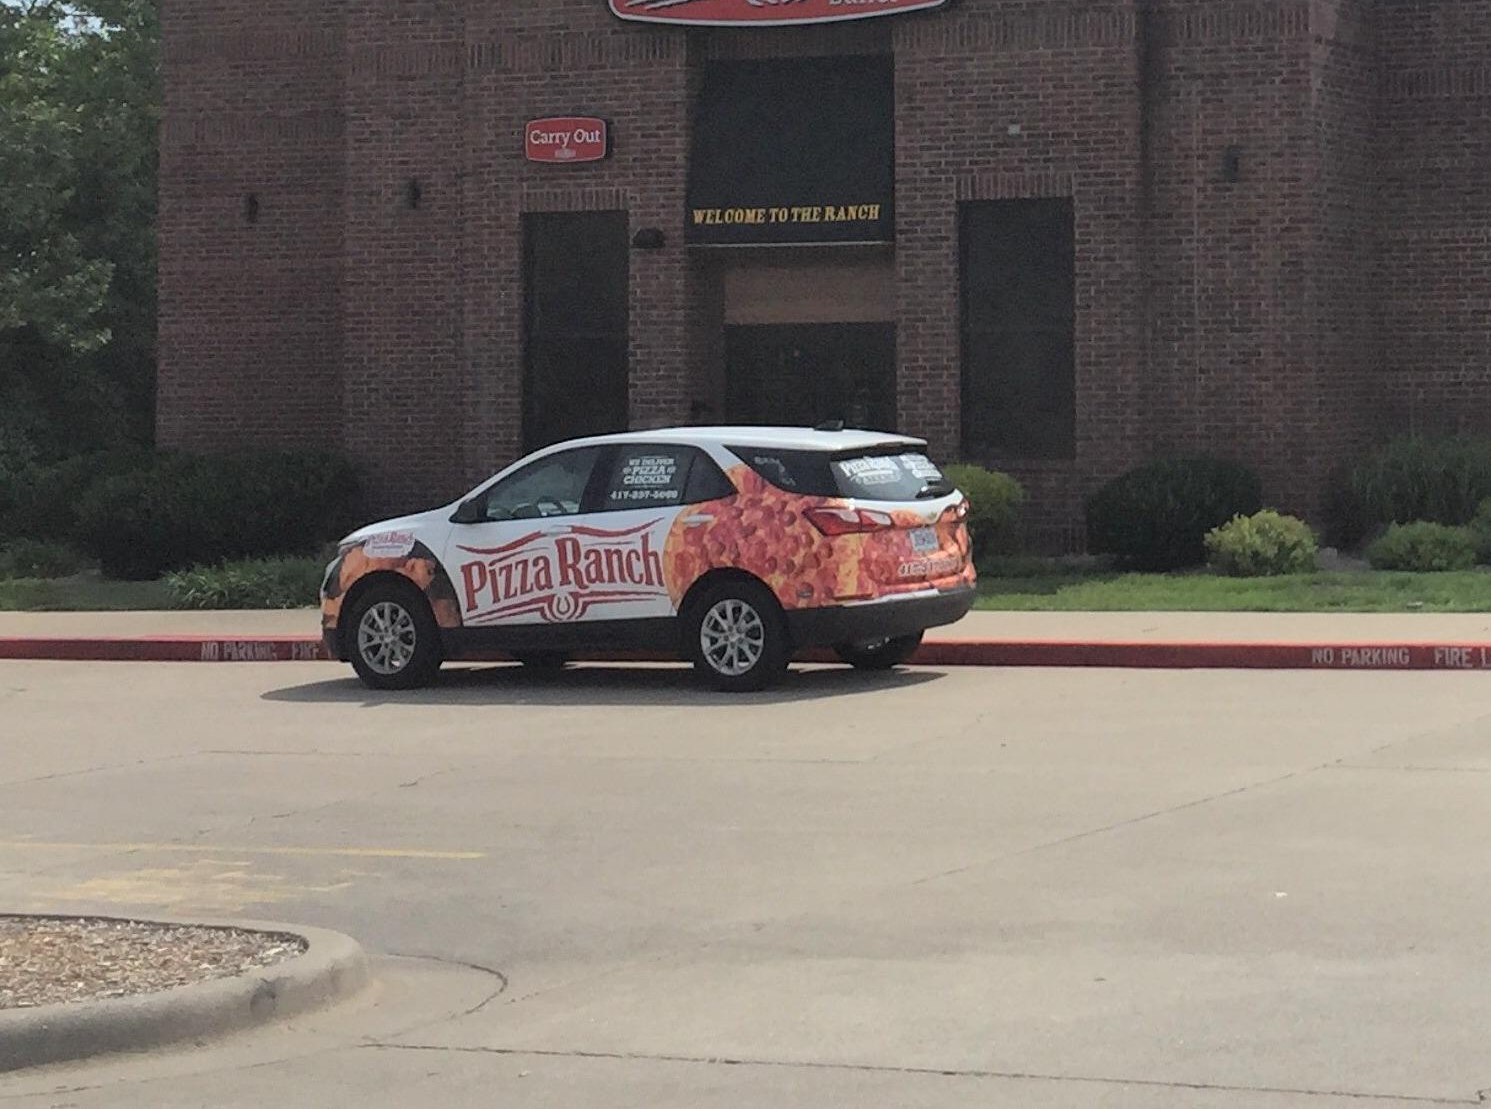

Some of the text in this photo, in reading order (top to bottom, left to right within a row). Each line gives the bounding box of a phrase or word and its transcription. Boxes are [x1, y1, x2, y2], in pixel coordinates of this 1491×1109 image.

[530, 128, 601, 147] Carry Out
[693, 204, 881, 225] WELCOME TO THE RANCH
[623, 474, 672, 485] CHICKEN
[632, 465, 666, 475] PIZZA
[460, 531, 665, 613] Pizza Ranch
[200, 641, 219, 660] NO
[1311, 647, 1335, 665] NO
[1341, 647, 1411, 666] PARKING
[1434, 647, 1474, 667] FIRE
